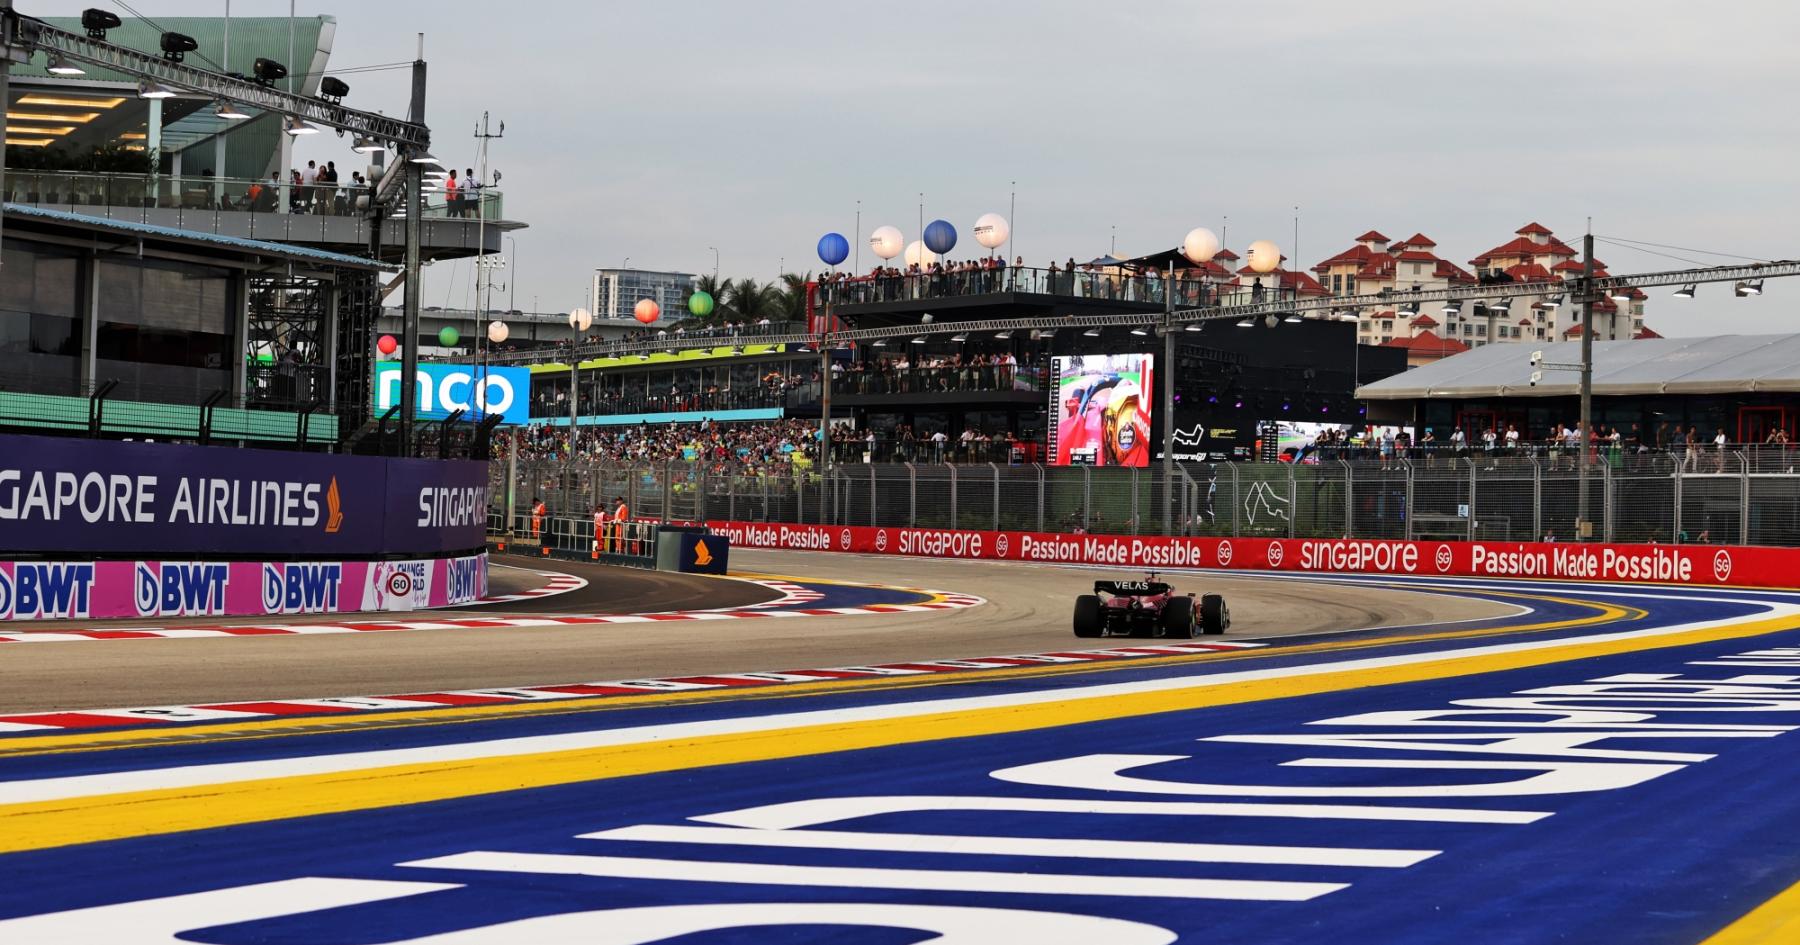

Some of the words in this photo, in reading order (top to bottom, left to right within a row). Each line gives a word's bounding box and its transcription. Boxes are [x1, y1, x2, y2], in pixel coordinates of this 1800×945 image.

[168, 477, 321, 526] AIRLINES
[745, 525, 777, 547] Made
[780, 526, 831, 549] Possible
[1021, 535, 1080, 559] Passion
[1084, 538, 1127, 563] Made
[1131, 540, 1201, 565] Possible
[455, 559, 477, 599] BWT
[1471, 545, 1547, 575] Passion
[1553, 548, 1598, 577] Made
[1602, 548, 1692, 581] Possible
[15, 563, 94, 615] BWT
[161, 564, 228, 613] BWT
[284, 564, 340, 609] BWT
[394, 580, 406, 590] 60
[412, 579, 425, 591] RLD
[1114, 581, 1149, 591] VELAS
